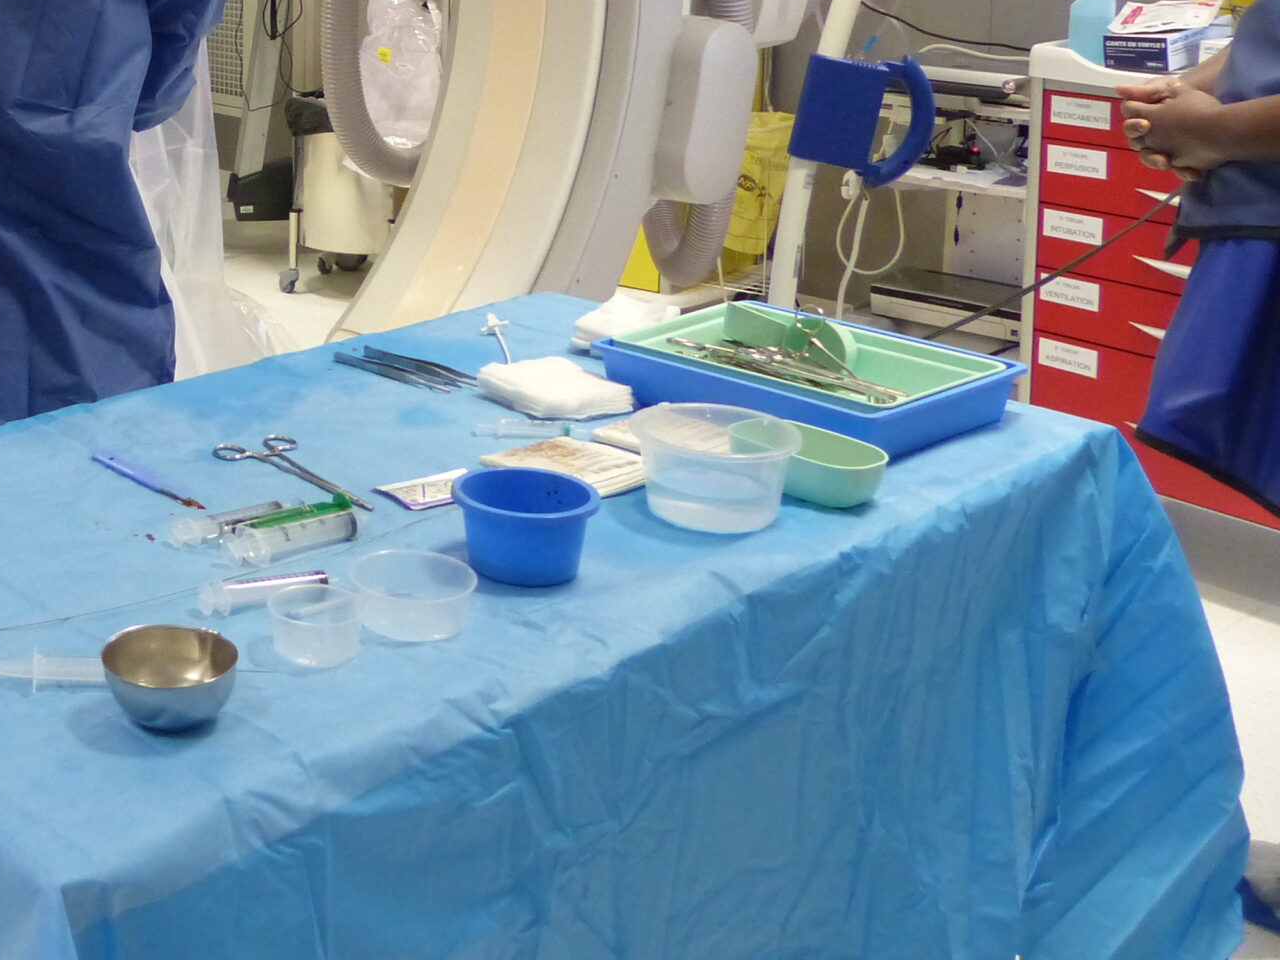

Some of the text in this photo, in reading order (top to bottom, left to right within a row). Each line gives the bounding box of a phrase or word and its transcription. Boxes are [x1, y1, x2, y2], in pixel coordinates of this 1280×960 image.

[1052, 111, 1109, 125] MEDICAMENTS
[1054, 161, 1099, 174] PERFUSION
[1050, 224, 1096, 239] INTUBATION
[1045, 289, 1095, 307] VENTILATION
[1045, 354, 1092, 371] ASPIRATION
